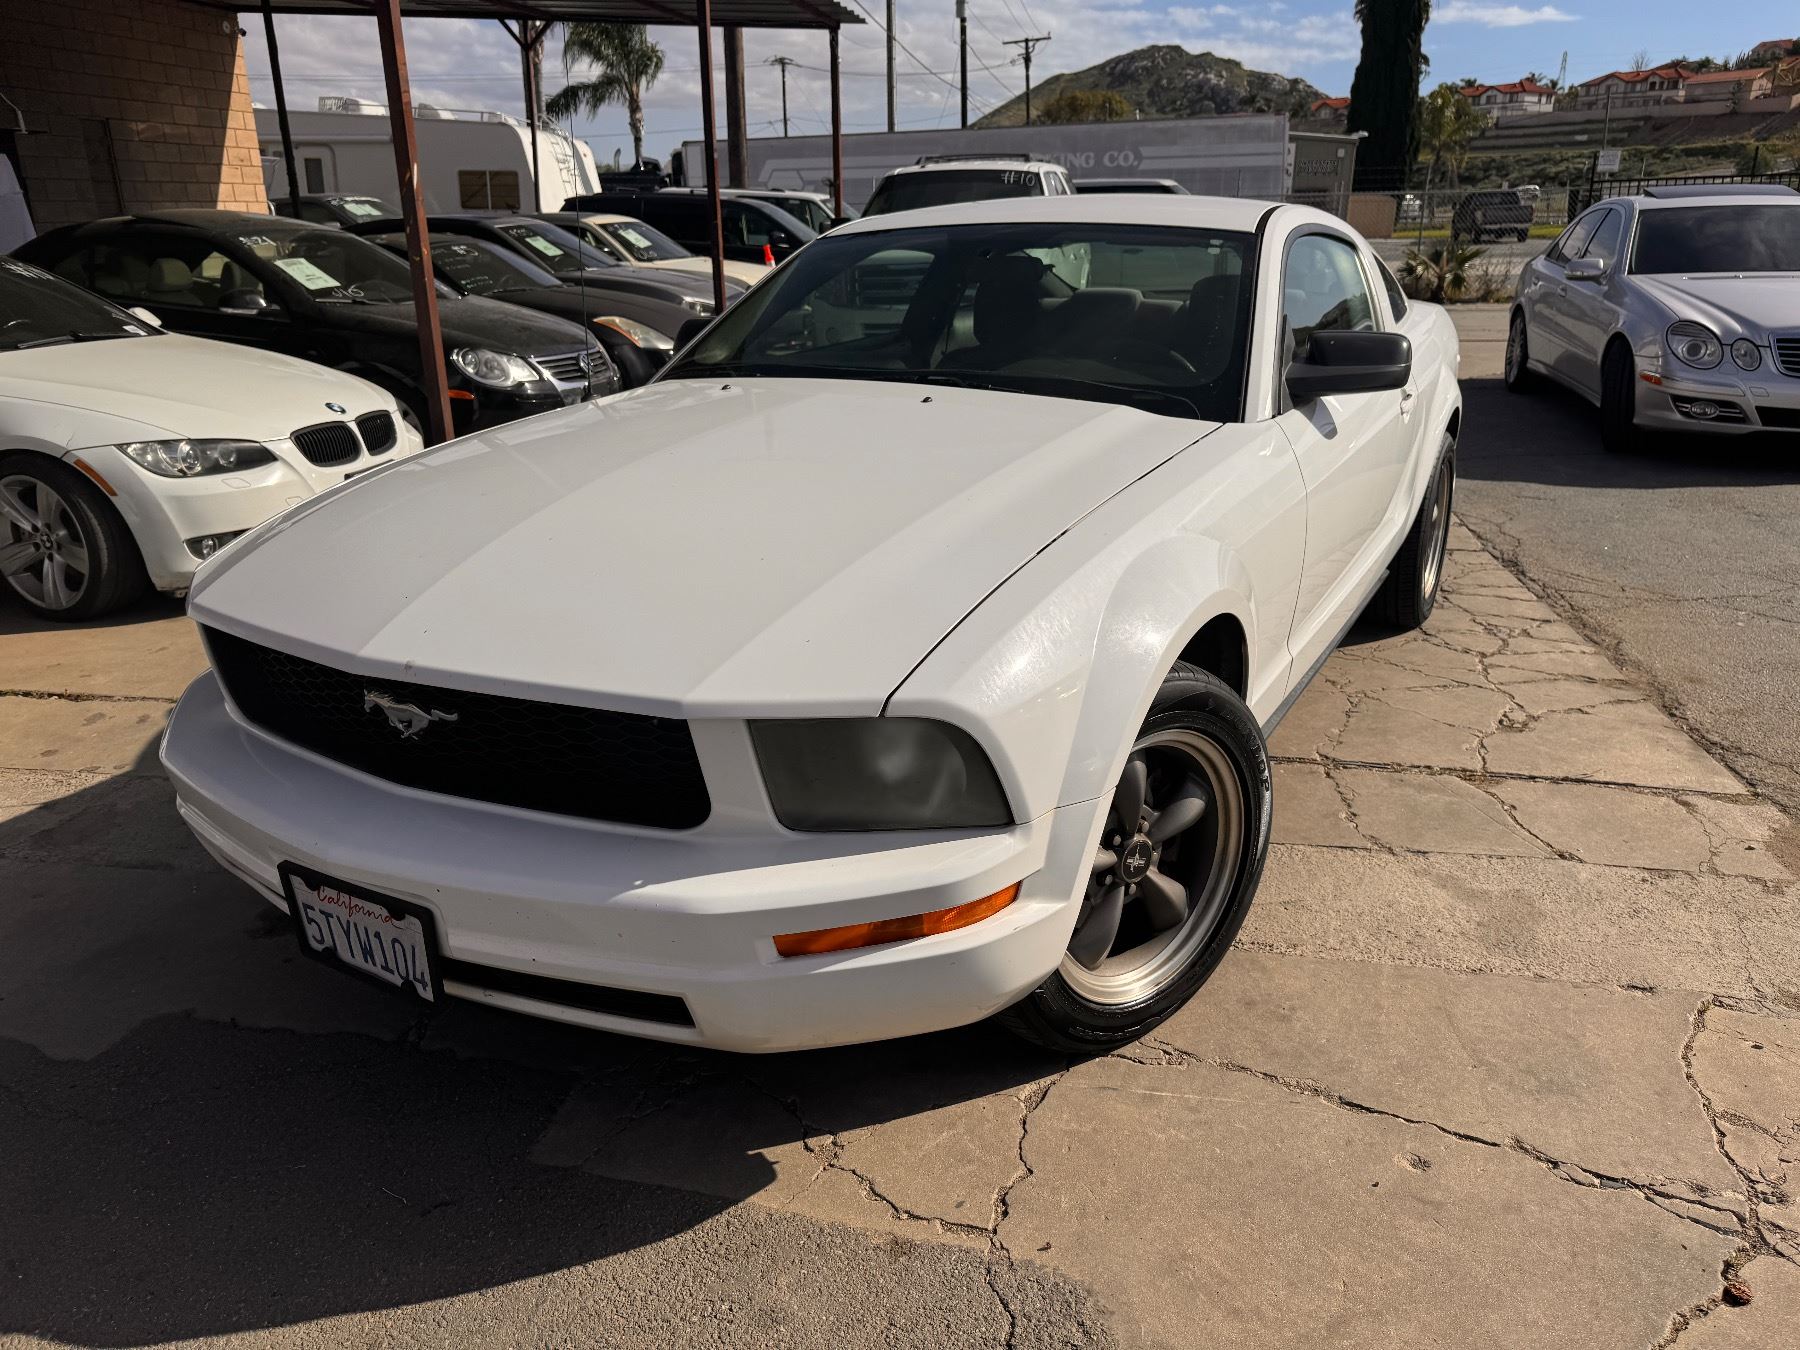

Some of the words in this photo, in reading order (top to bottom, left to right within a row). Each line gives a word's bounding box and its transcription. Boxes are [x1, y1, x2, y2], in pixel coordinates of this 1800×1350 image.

[1103, 150, 1139, 168] CO.
[1000, 171, 1036, 187] #10
[317, 885, 403, 929] California
[302, 903, 428, 991] 5TYW104
